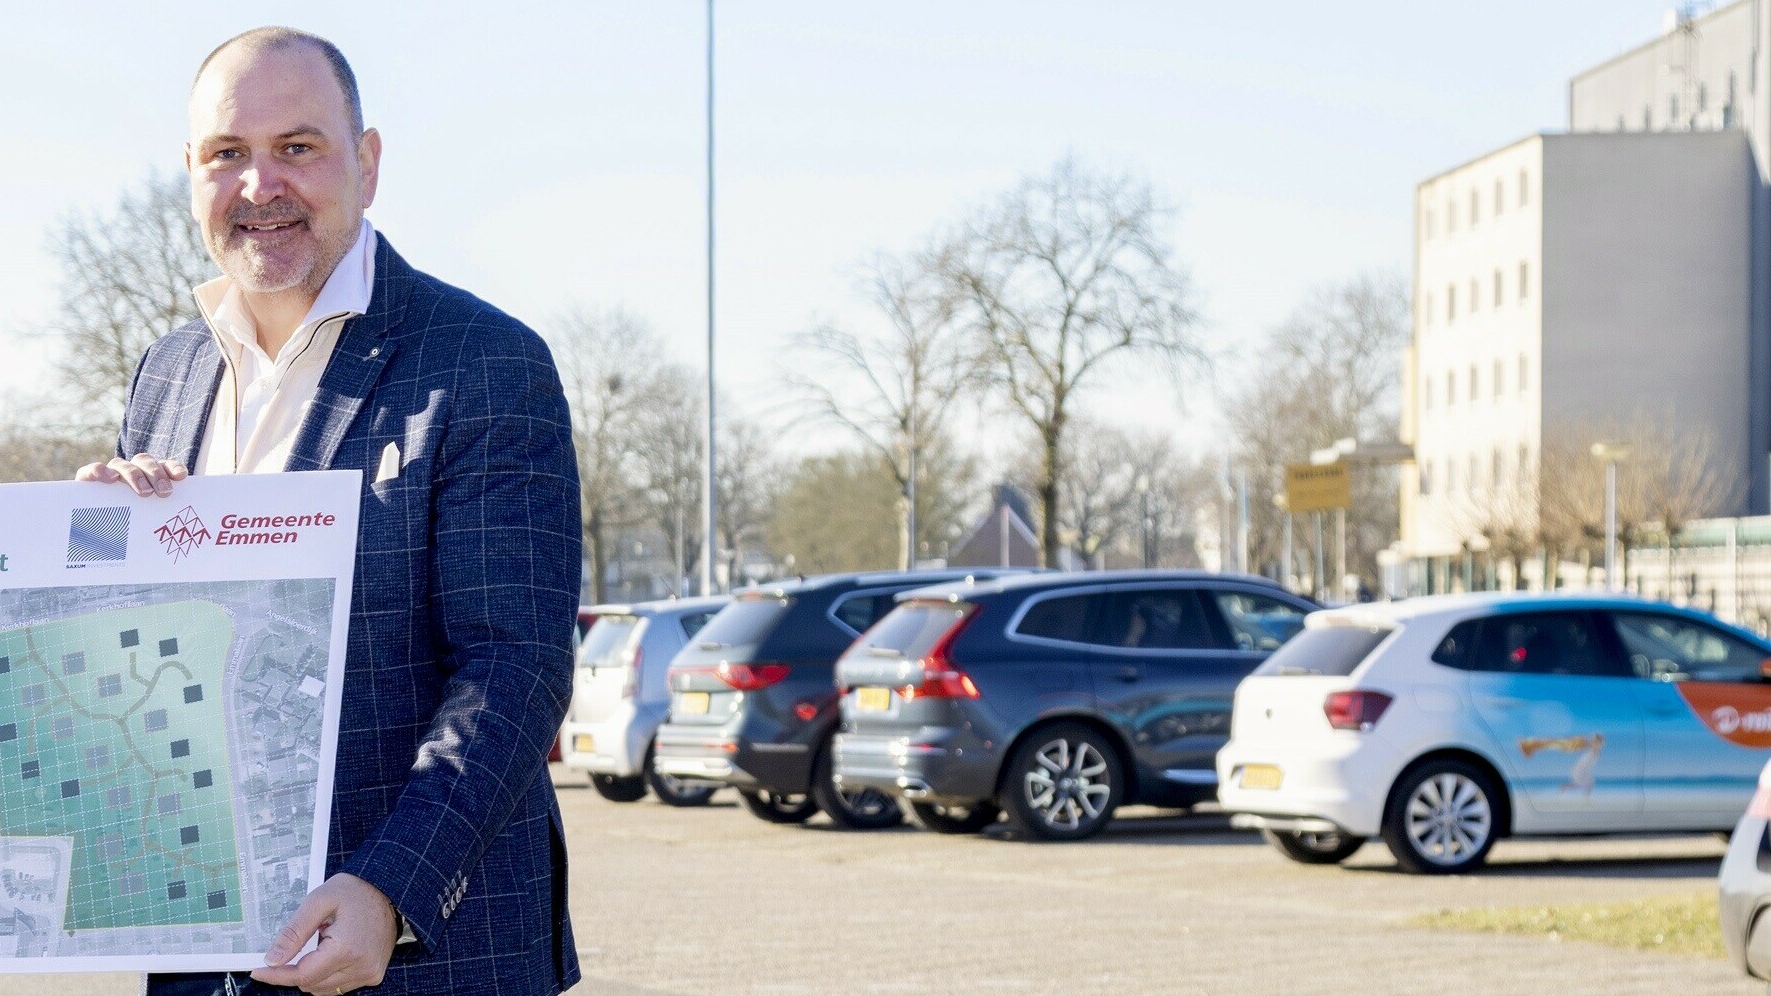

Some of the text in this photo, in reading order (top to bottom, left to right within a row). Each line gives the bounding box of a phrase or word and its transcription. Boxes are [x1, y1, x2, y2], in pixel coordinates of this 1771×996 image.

[221, 512, 335, 529] Gemeente
[215, 529, 298, 546] Emmen
[96, 601, 145, 613] Kerkhoflaan
